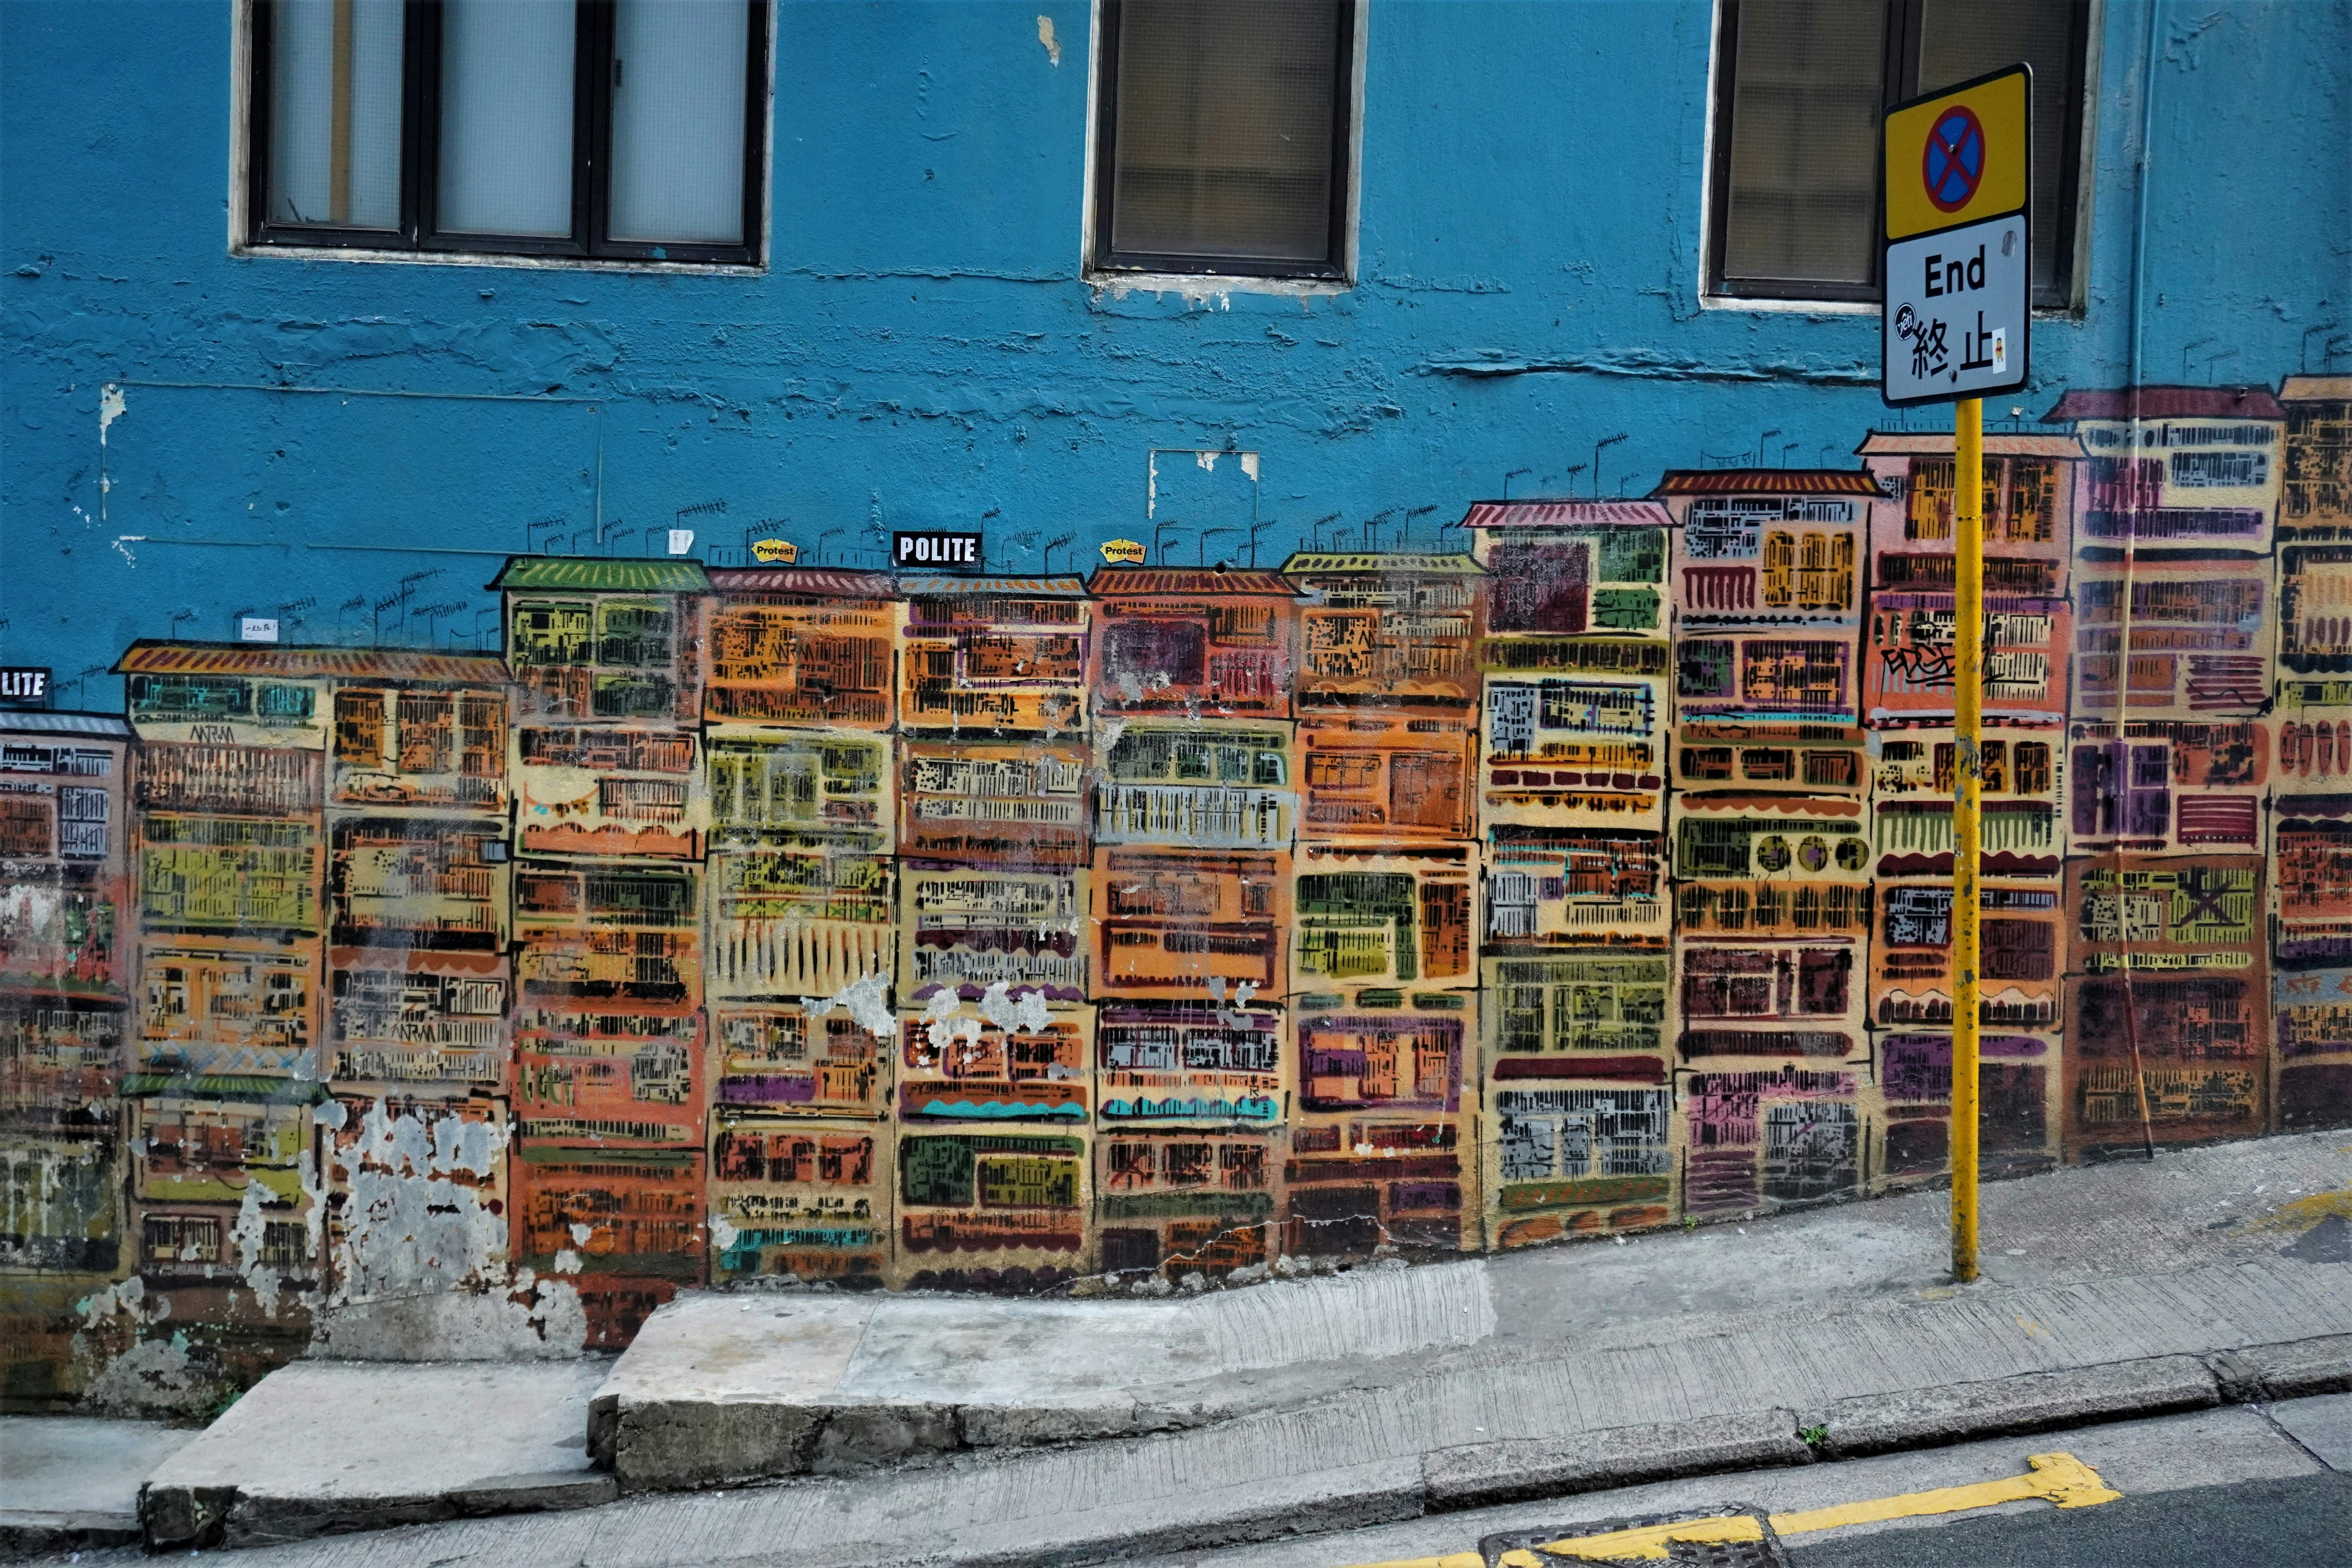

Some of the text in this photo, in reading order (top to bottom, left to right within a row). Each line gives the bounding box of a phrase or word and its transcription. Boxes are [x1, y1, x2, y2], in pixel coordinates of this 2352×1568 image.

[1925, 244, 1985, 298] End
[1911, 310, 1993, 380] 終止
[757, 545, 794, 557] Protest
[900, 537, 975, 561] POLITE
[1105, 546, 1143, 557] Protest
